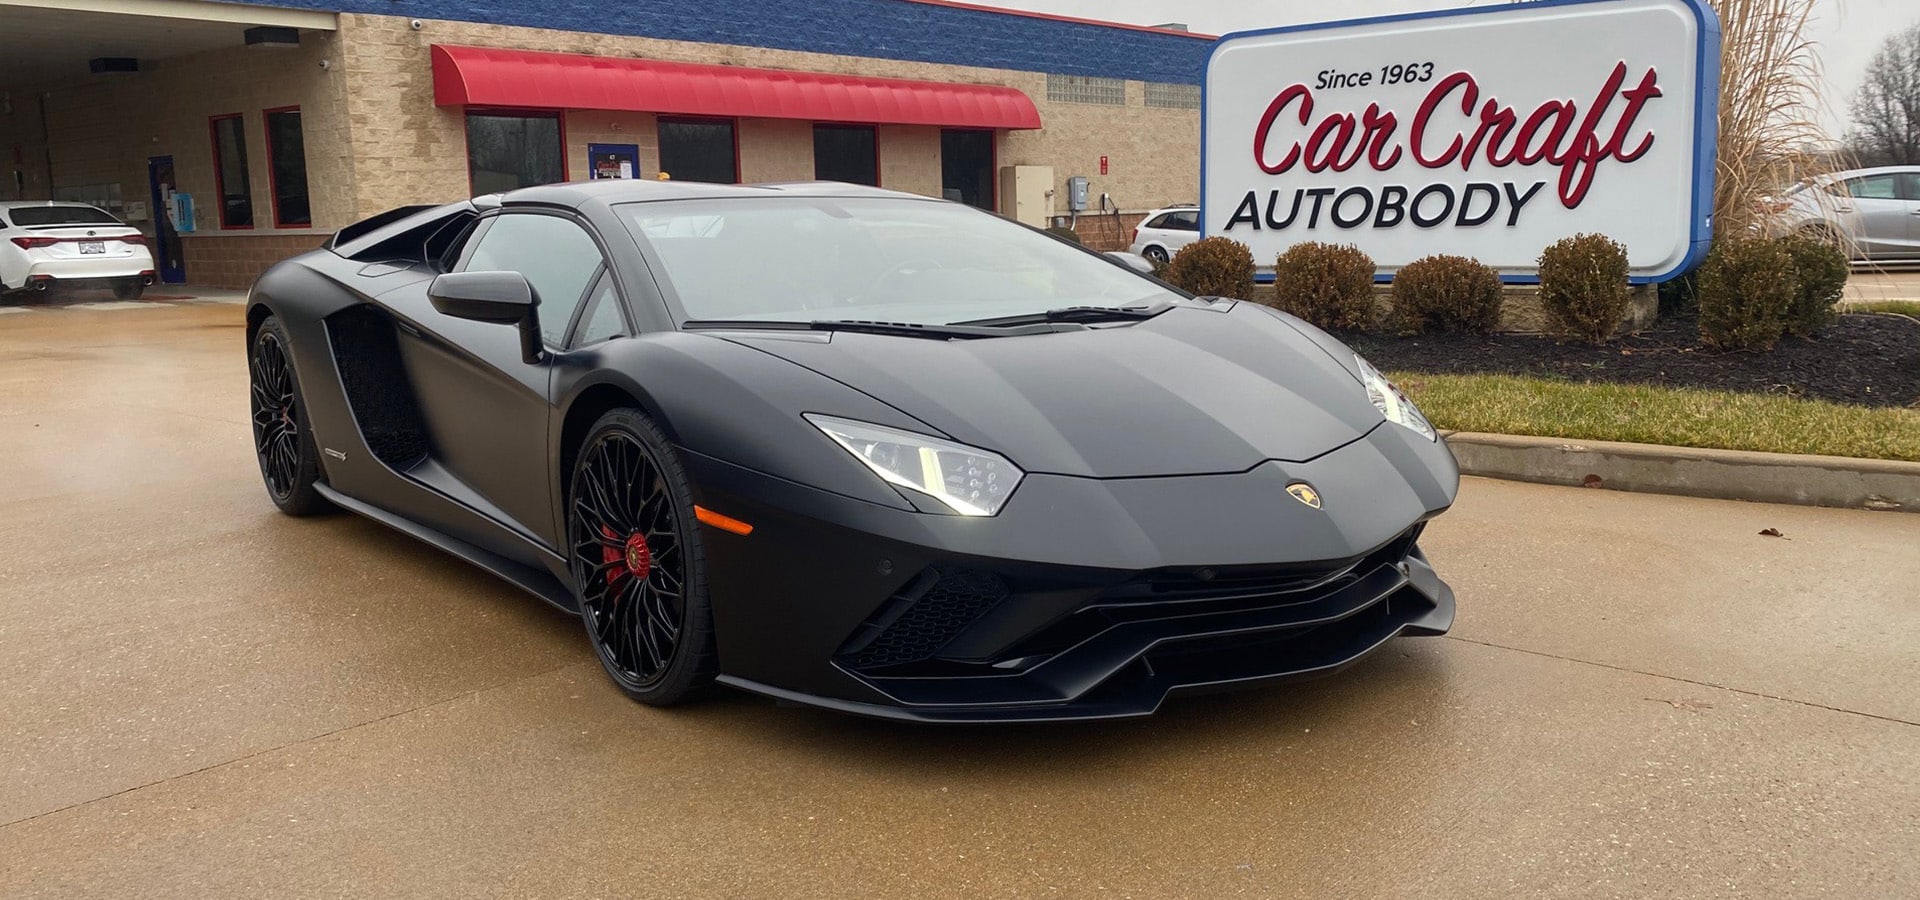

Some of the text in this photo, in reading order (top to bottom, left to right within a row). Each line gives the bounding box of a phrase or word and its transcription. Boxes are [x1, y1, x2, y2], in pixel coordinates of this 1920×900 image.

[1314, 61, 1435, 90] Since 1963
[1253, 61, 1663, 210] Car Craft
[1223, 181, 1546, 231] AUTOBODY
